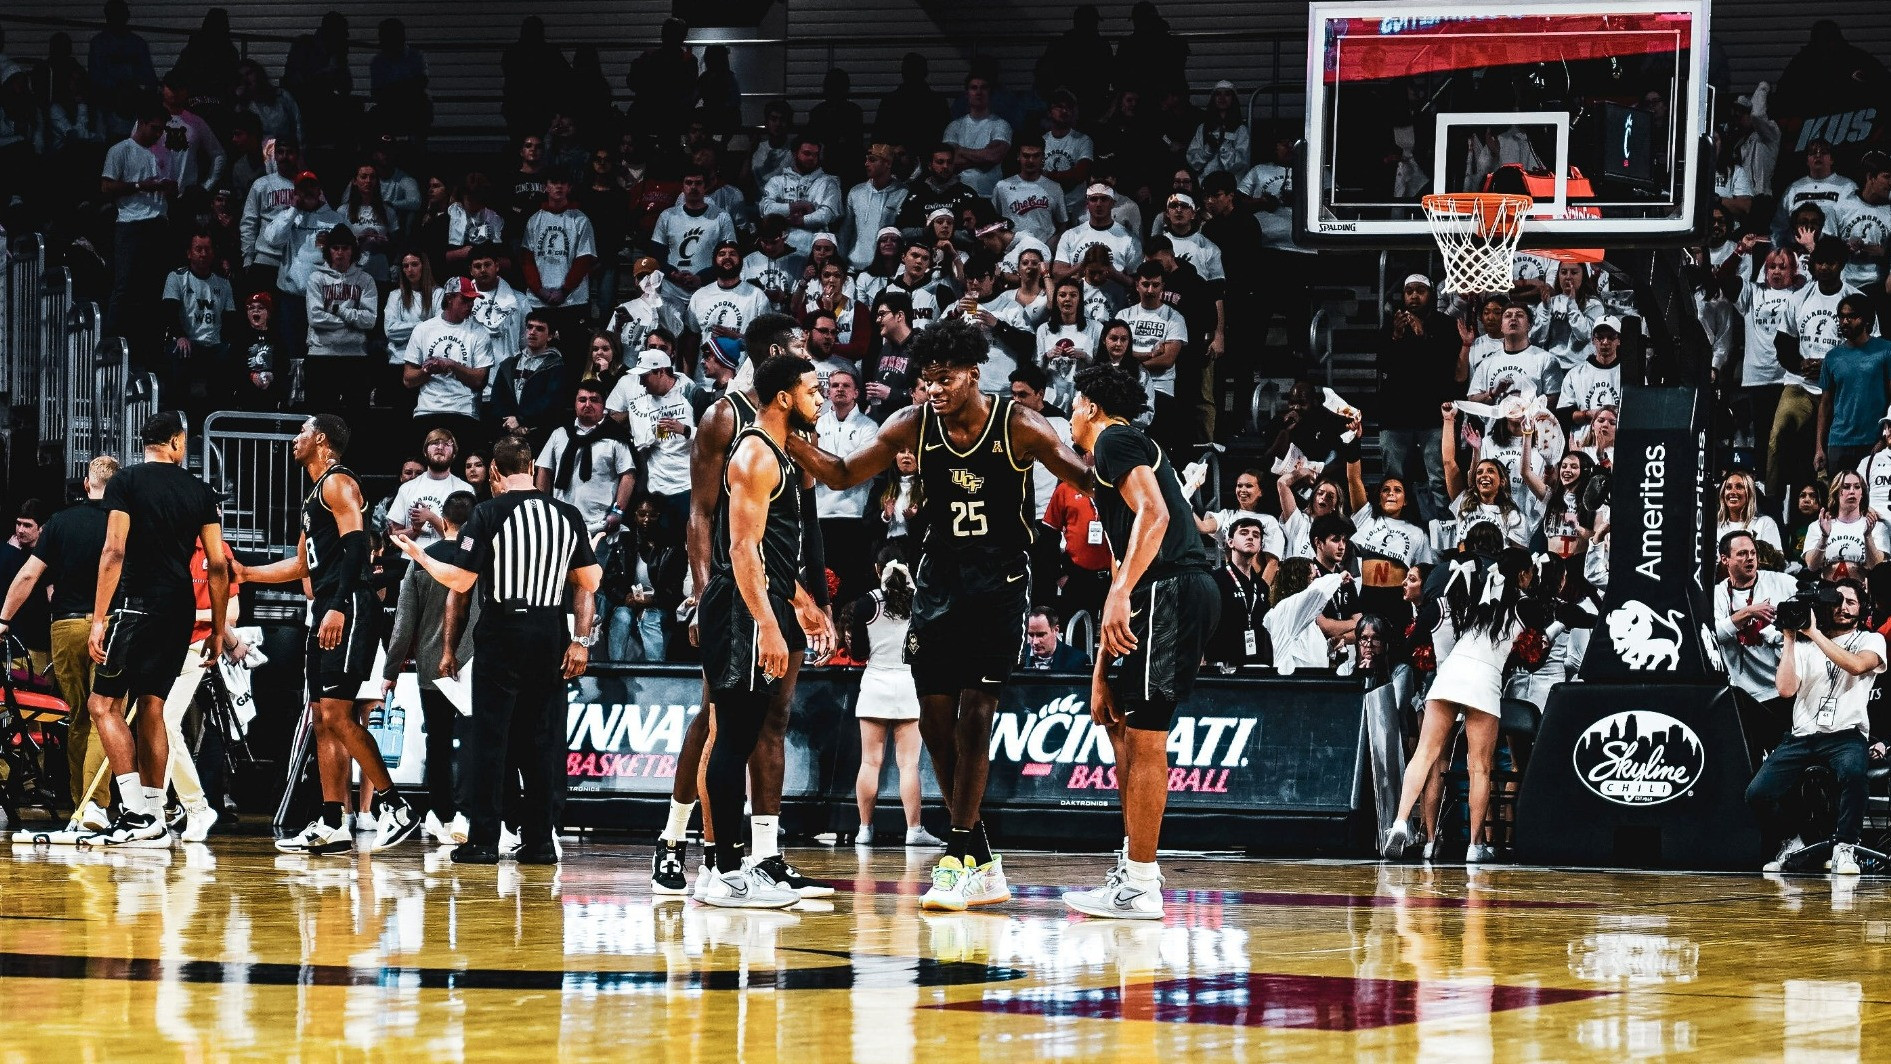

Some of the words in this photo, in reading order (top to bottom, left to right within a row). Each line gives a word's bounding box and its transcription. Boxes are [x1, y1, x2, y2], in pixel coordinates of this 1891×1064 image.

[1319, 223, 1356, 232] SPALDING
[951, 469, 984, 494] UCF
[951, 501, 988, 537] 25
[1373, 562, 1390, 585] N
[567, 752, 677, 778] BASKETB
[1588, 741, 1690, 785] Skyline
[1607, 783, 1667, 792] CHILI
